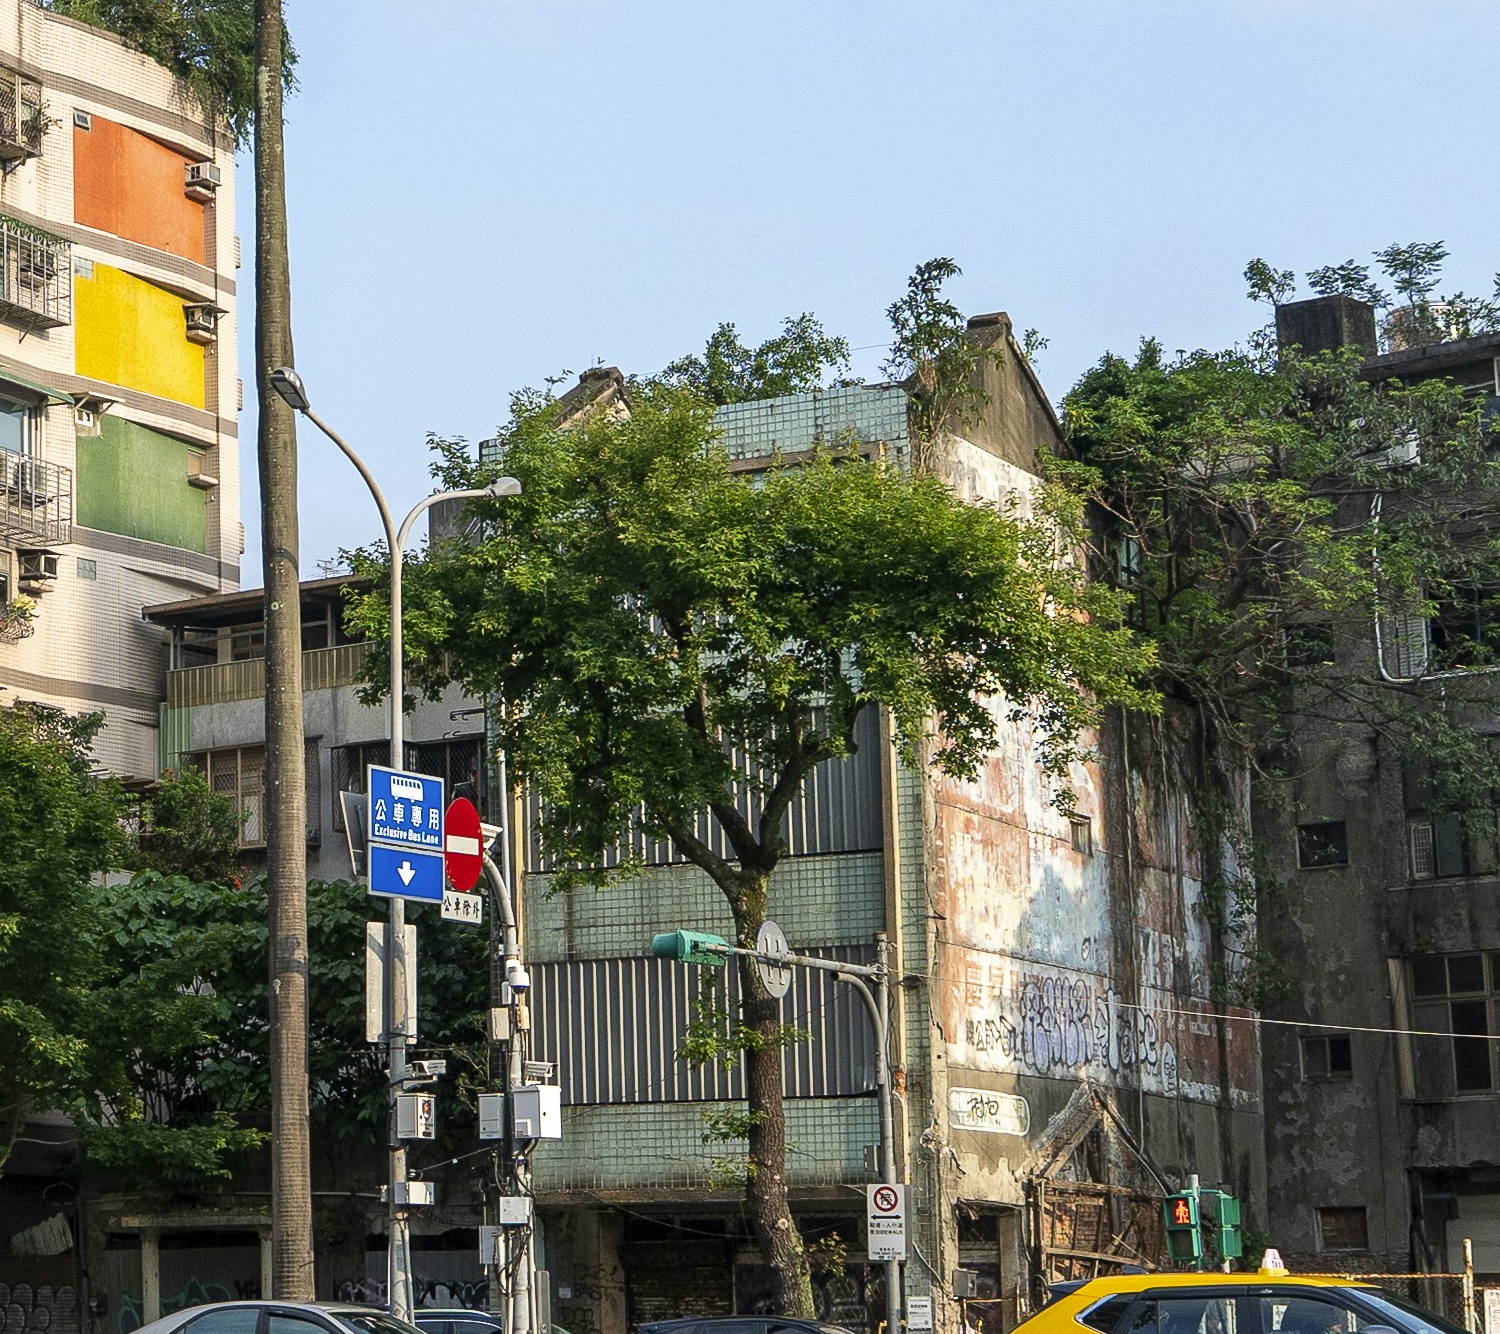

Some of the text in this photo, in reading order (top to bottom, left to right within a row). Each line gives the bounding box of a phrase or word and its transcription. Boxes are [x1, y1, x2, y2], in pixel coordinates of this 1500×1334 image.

[374, 798, 440, 831] 公車專用
[374, 823, 439, 845] Exclusive Bus Lane
